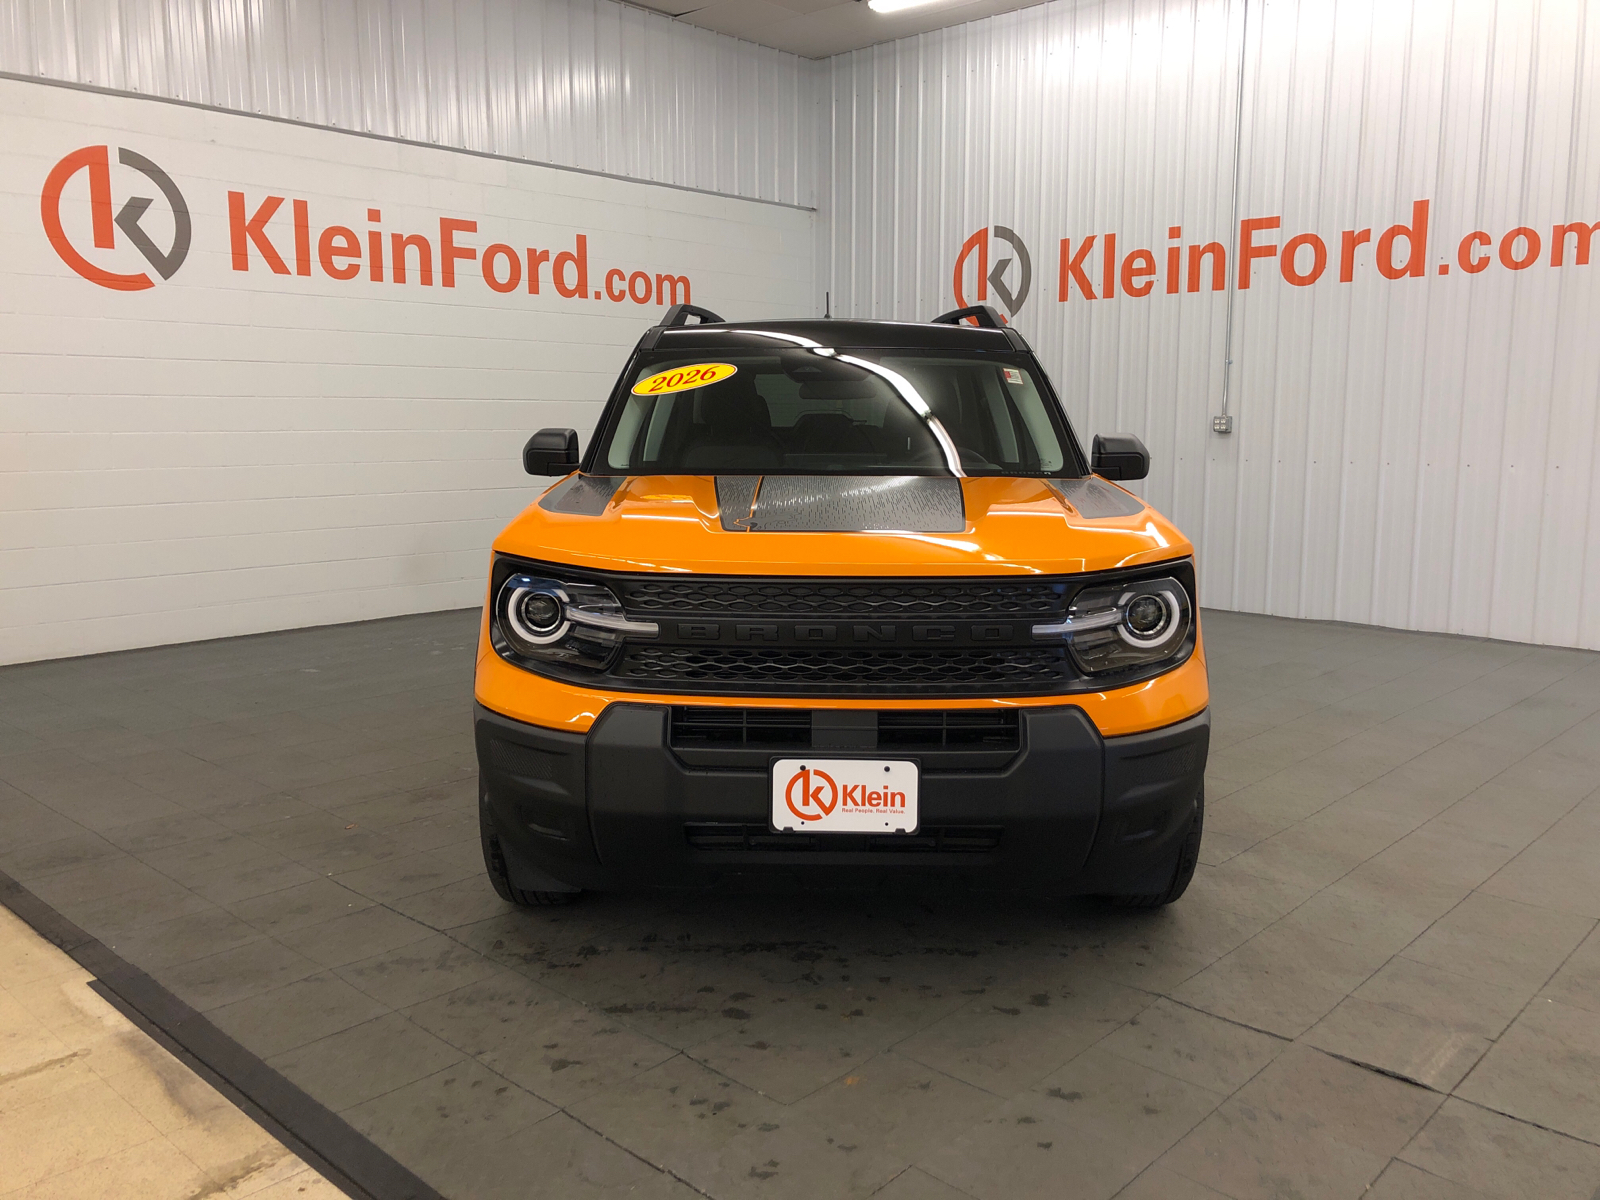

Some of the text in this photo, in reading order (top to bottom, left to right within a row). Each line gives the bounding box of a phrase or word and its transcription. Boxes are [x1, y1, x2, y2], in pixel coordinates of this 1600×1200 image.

[227, 190, 692, 307] KleinFord.com
[1058, 199, 1600, 303] KleinFord.com
[647, 365, 721, 393] 2026
[676, 622, 1014, 642] BRONCO
[842, 784, 906, 808] Klein
